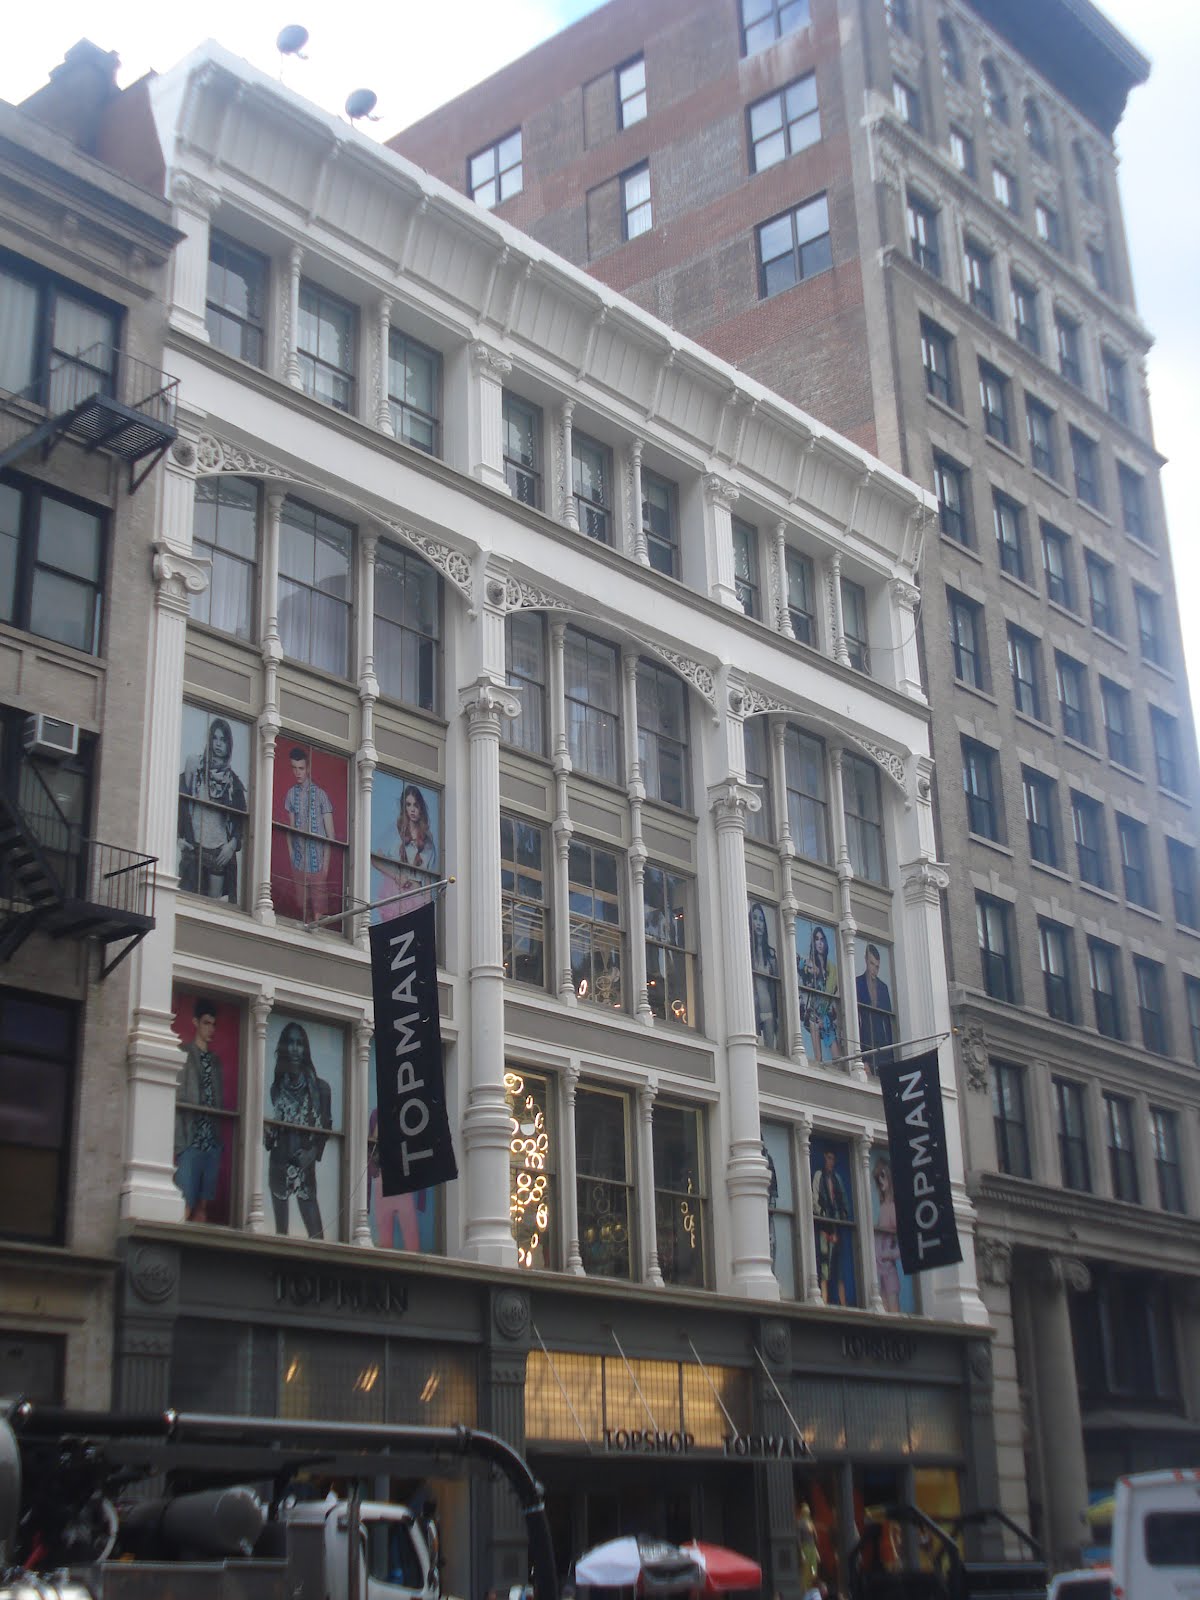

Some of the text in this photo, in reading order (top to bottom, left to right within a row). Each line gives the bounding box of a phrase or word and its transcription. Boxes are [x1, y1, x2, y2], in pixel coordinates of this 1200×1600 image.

[389, 929, 433, 1177] TOPMAN
[898, 1069, 942, 1261] TOPMAN
[267, 1270, 409, 1314] TOPMAN
[602, 1426, 810, 1460] TOPSHOP TOPMAN
